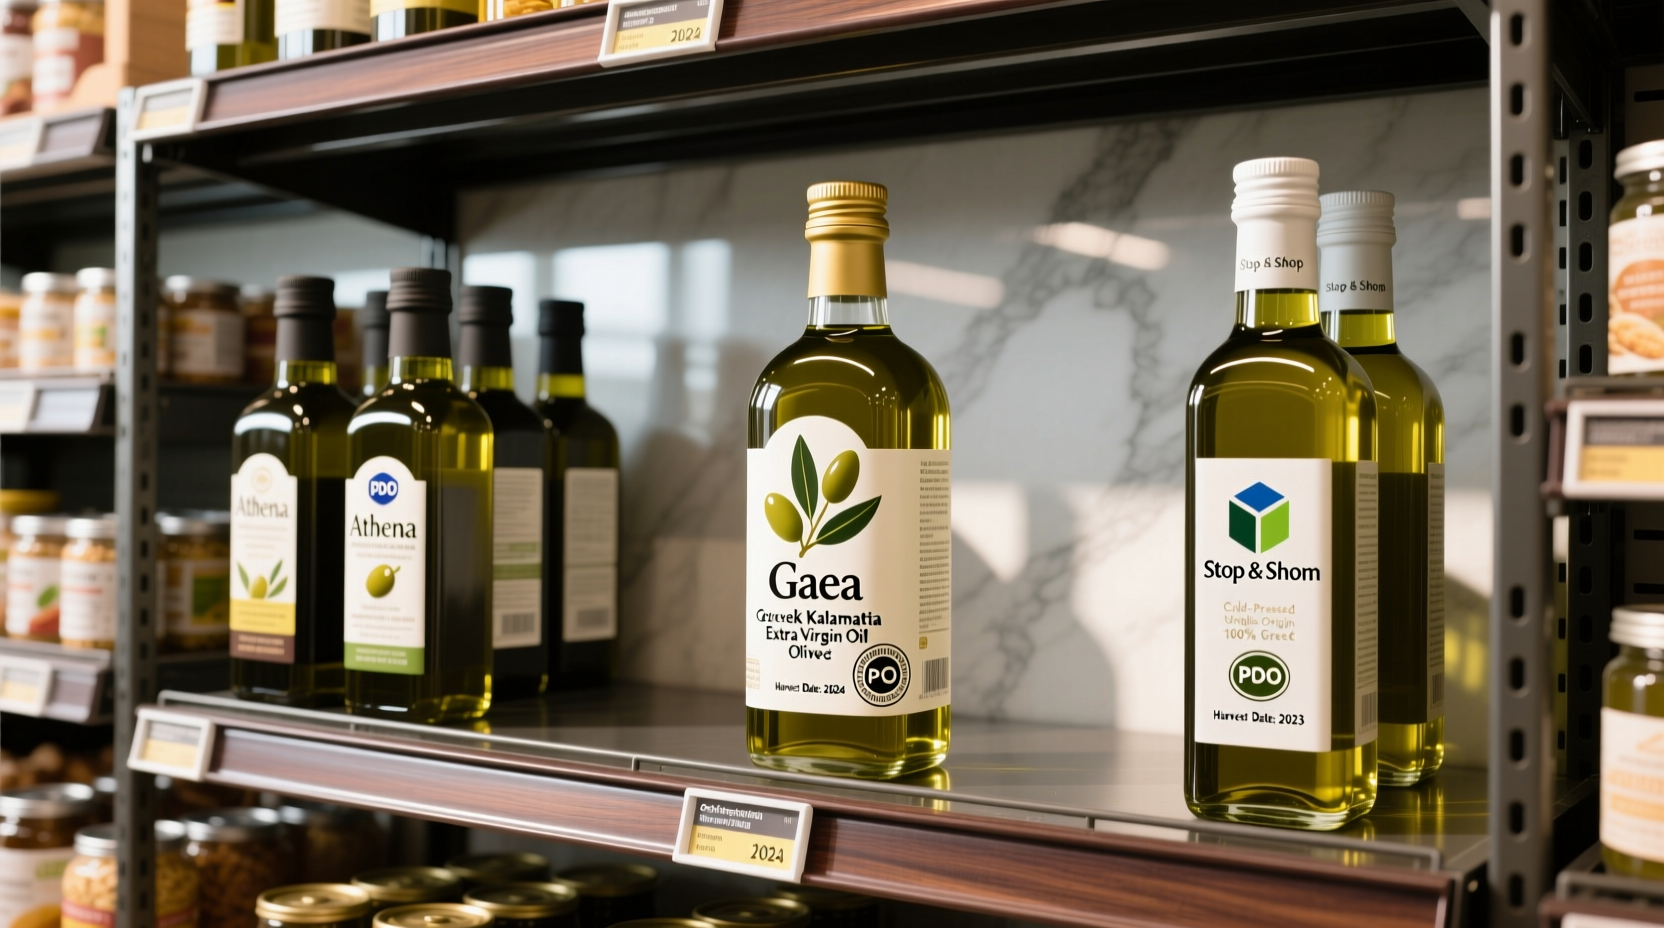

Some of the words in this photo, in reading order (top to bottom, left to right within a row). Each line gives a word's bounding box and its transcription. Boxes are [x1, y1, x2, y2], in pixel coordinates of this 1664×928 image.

[1274, 256, 1304, 272] Shop
[370, 480, 398, 496] PDO
[236, 496, 289, 518] Athena
[350, 513, 417, 538] Athena
[768, 561, 864, 601] Gaea
[1204, 560, 1245, 584] Stop
[1248, 561, 1263, 580] &
[1265, 561, 1321, 581] Shom
[766, 626, 798, 641] Extra
[800, 627, 843, 646] Virgin
[846, 628, 869, 643] Oil
[868, 665, 898, 685] PO
[1238, 665, 1282, 685] PDO
[1278, 713, 1305, 726] 2023
[750, 843, 784, 863] 2024
